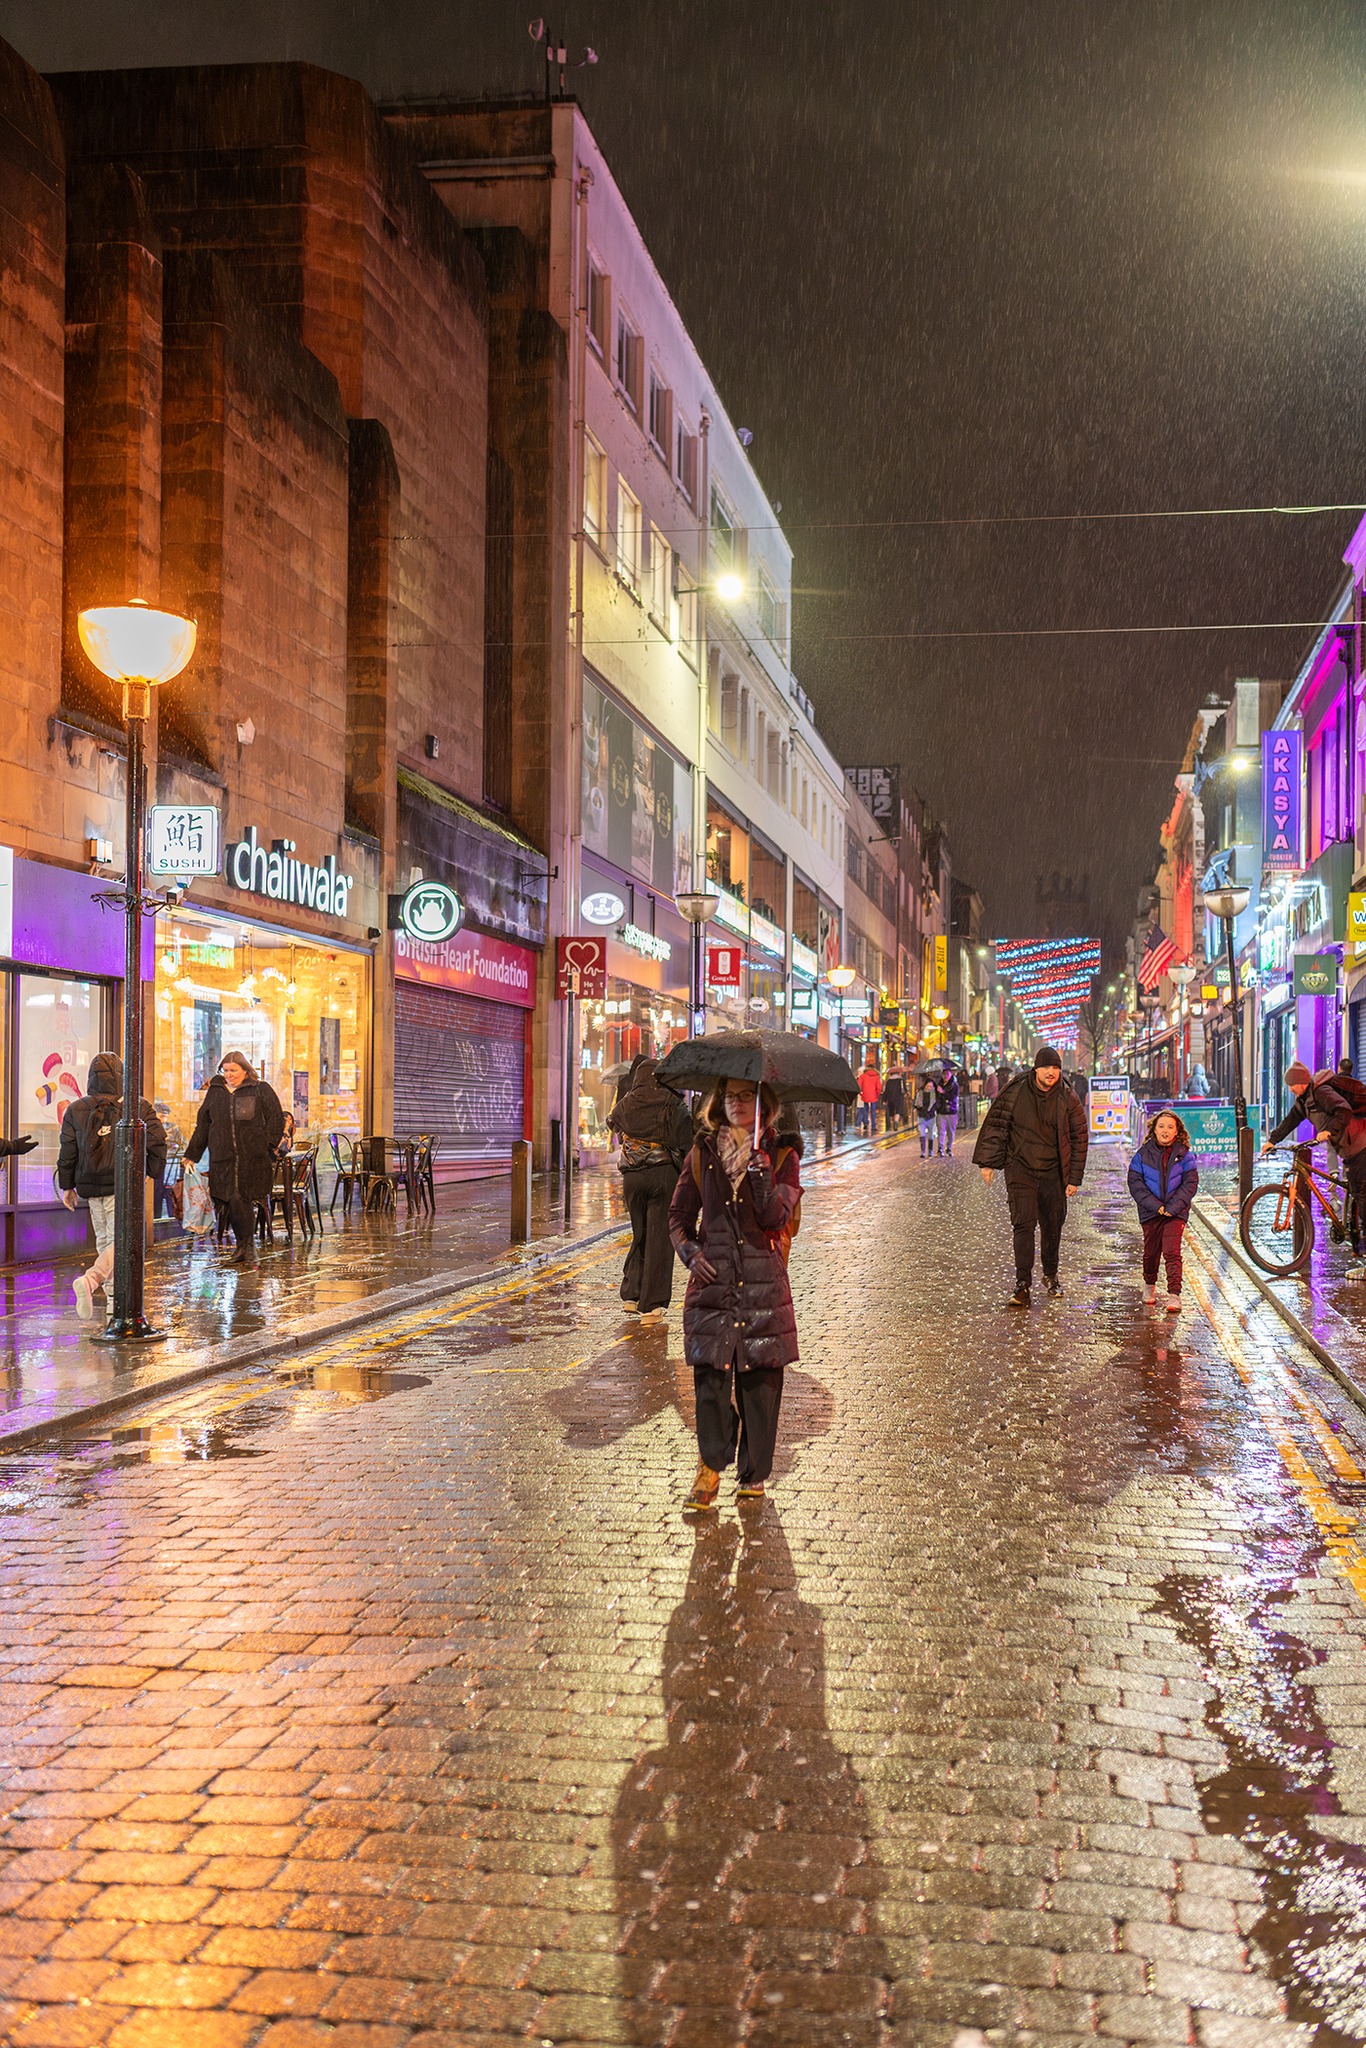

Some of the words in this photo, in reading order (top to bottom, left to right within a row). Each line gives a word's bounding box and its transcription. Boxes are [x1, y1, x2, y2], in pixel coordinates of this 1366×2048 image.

[1272, 738, 1290, 850] AKASYA
[163, 812, 203, 854] 鮨
[159, 858, 206, 868] SUSHI
[397, 936, 438, 966] British
[440, 941, 471, 974] Heart
[473, 949, 528, 988] Foundation
[1224, 1143, 1238, 1151] 737
